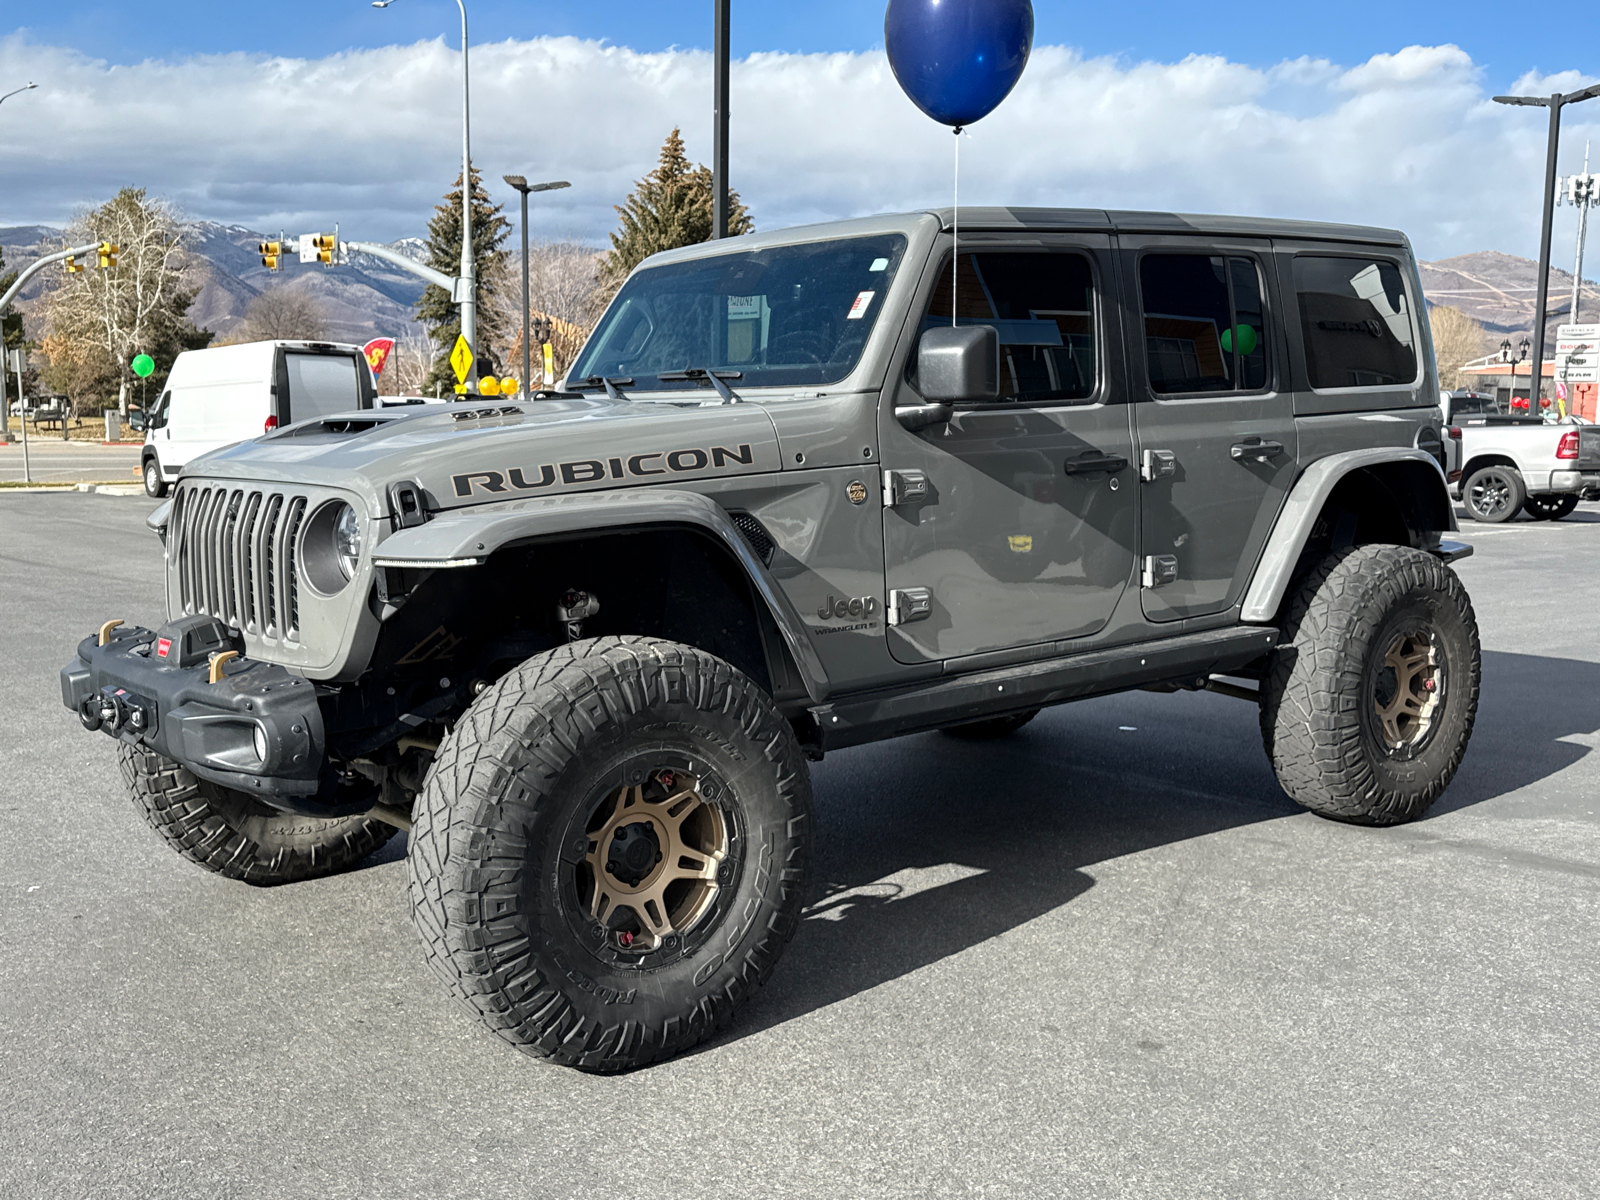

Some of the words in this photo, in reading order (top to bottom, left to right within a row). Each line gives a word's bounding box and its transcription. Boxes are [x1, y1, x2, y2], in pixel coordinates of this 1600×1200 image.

[451, 444, 754, 498] RUBICON
[818, 594, 877, 620] Jeep
[814, 623, 868, 636] WRANGLER
